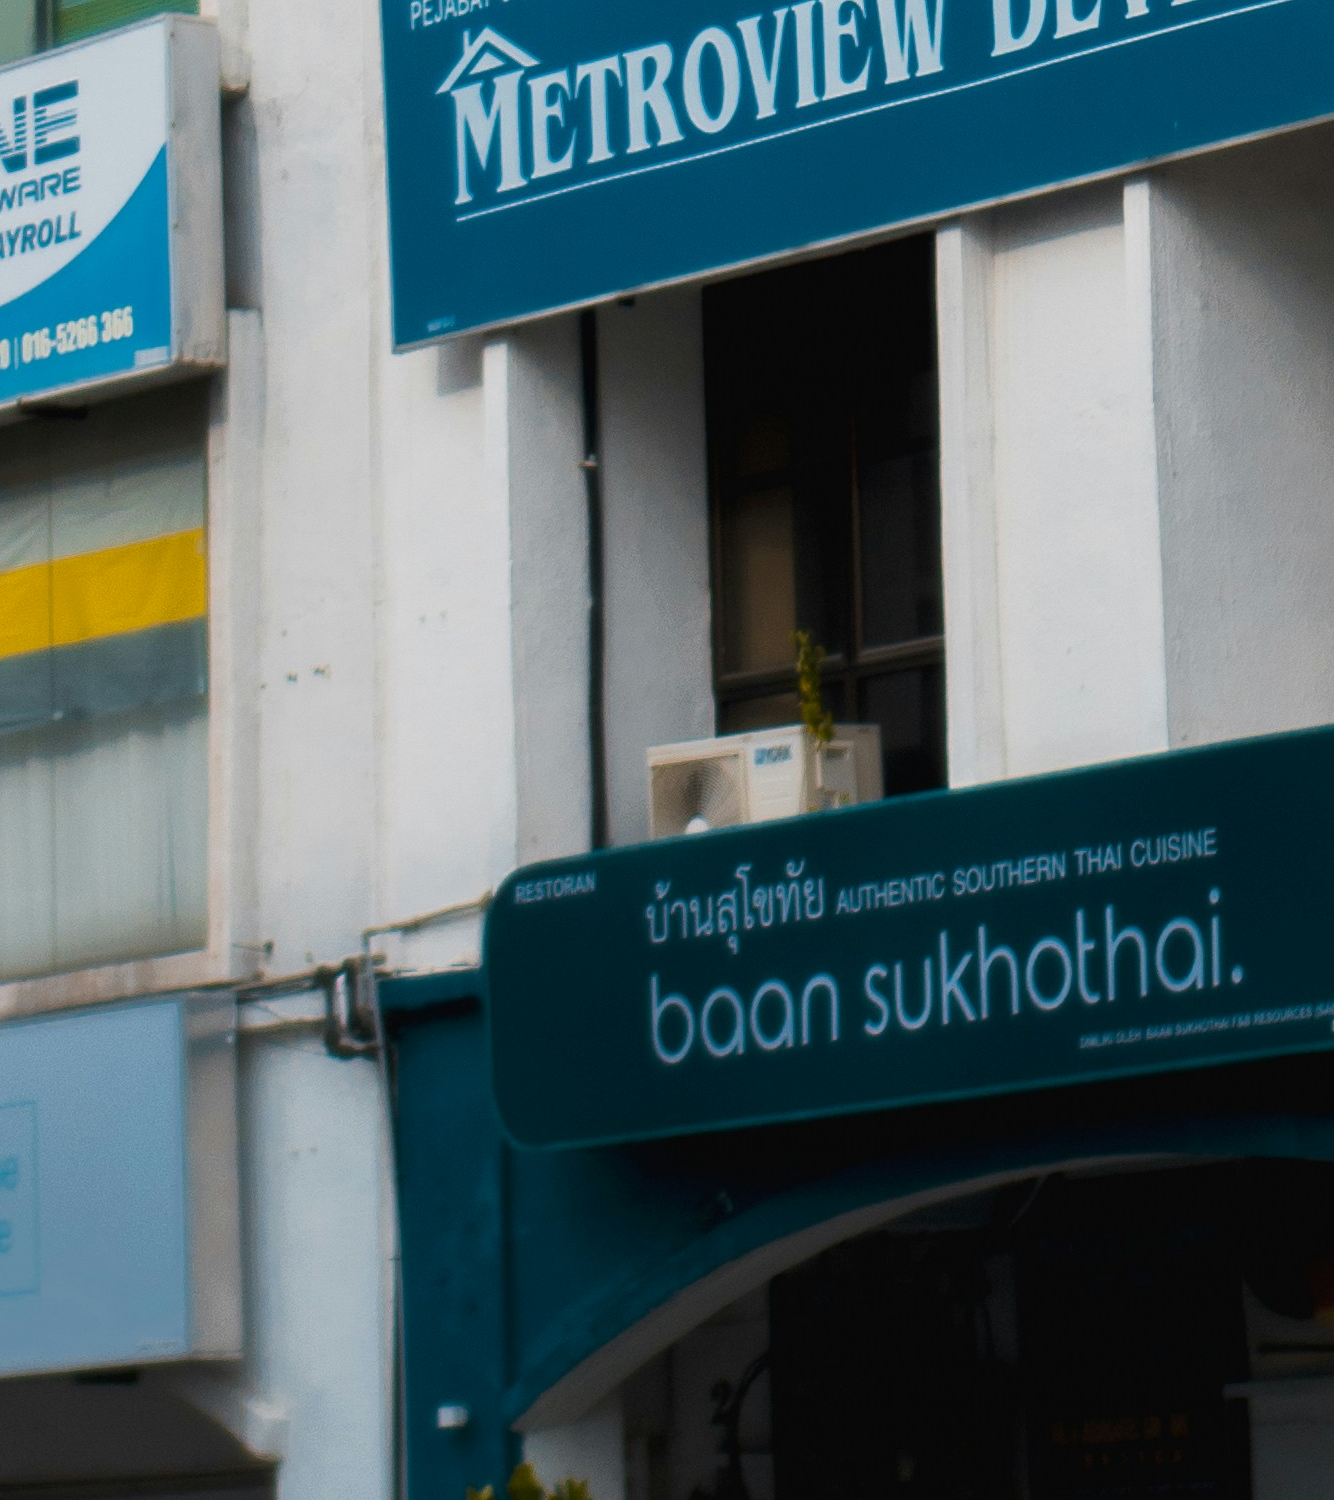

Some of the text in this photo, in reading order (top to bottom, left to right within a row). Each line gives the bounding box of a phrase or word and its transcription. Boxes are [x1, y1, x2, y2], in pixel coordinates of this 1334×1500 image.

[21, 315, 98, 364] 016-5266
[100, 306, 134, 343] 366
[514, 870, 597, 904] RESTORAN
[644, 857, 827, 956] บ้านสุโขทัย
[835, 828, 1219, 916] AUTHENTIC SOUTHERN THAI CUISINE
[649, 887, 1245, 1066] baan sukhothai.
